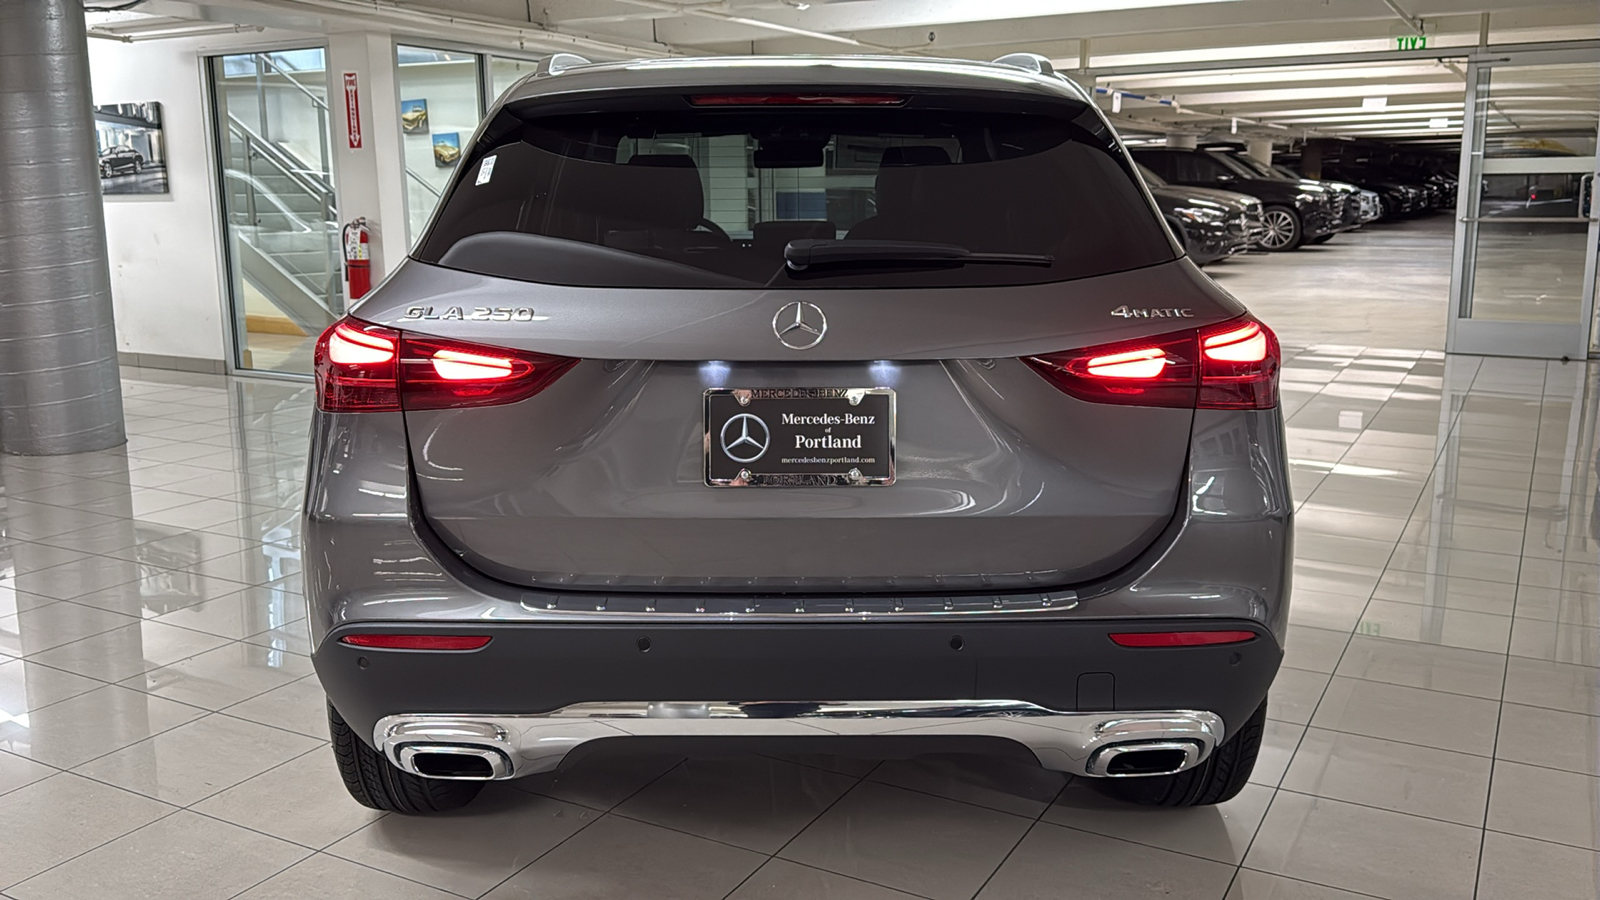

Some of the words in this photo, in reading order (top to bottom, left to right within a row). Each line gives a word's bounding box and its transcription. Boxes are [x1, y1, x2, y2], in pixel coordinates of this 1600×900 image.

[404, 306, 464, 320] GLA
[471, 306, 535, 322] 250
[1110, 304, 1195, 319] 4MATIC
[781, 412, 876, 425] Mercedes-Benz
[794, 434, 862, 448] Portland
[781, 456, 876, 465] mercedesbenzportland.com
